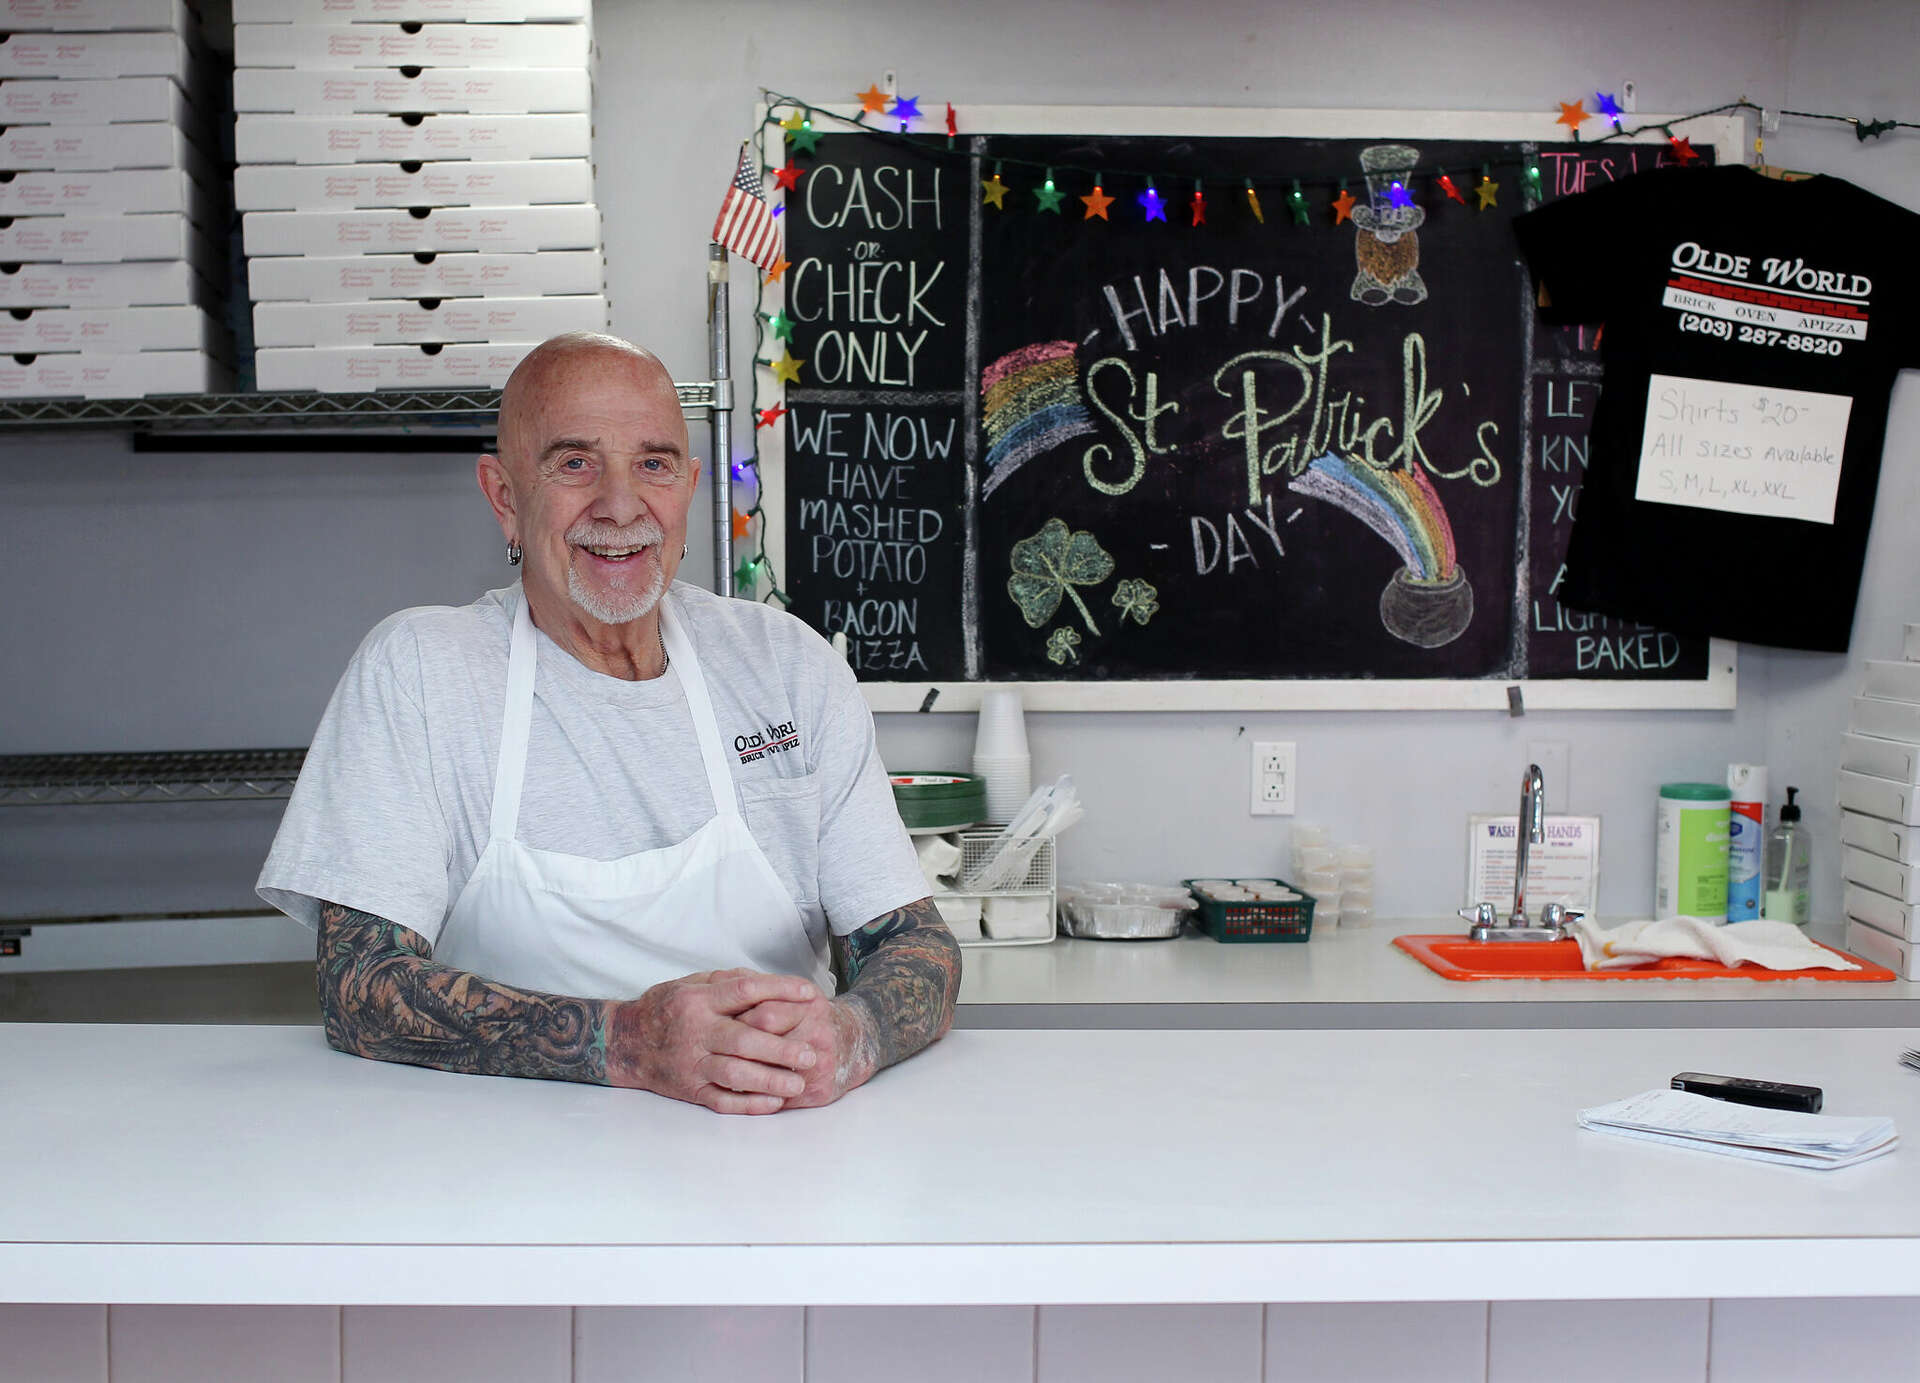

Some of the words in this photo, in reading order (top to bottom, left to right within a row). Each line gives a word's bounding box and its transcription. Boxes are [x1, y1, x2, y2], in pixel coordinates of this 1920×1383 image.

[806, 164, 943, 231] CASH
[854, 242, 882, 261] OR
[1671, 242, 1751, 279] OLDE
[1761, 258, 1873, 298] WORLD
[791, 257, 946, 328] CHECK
[1103, 266, 1307, 352] HAPPY
[1673, 294, 1717, 313] BRICK
[1735, 304, 1777, 323] OVEN
[1798, 317, 1858, 336] APIZZA
[1679, 312, 1734, 341] (203)
[1738, 325, 1844, 357] 287-8820
[814, 330, 929, 388] ONLY
[1083, 357, 1180, 496] St.
[1213, 312, 1500, 506] Patrick's
[1548, 380, 1603, 418] LE
[1657, 387, 1741, 426] Shirts
[791, 408, 851, 457] WE
[863, 412, 956, 461] NOW
[1649, 432, 1684, 457] All
[827, 461, 916, 500] HAVE
[800, 497, 944, 545] MASHED
[1190, 494, 1286, 576] DAY
[812, 534, 927, 585] POTATO
[823, 598, 918, 638] BACON
[1576, 632, 1680, 671] BAKED
[740, 751, 765, 765] BRICK
[1488, 825, 1516, 838] WASH
[1547, 825, 1582, 838] HANDS
